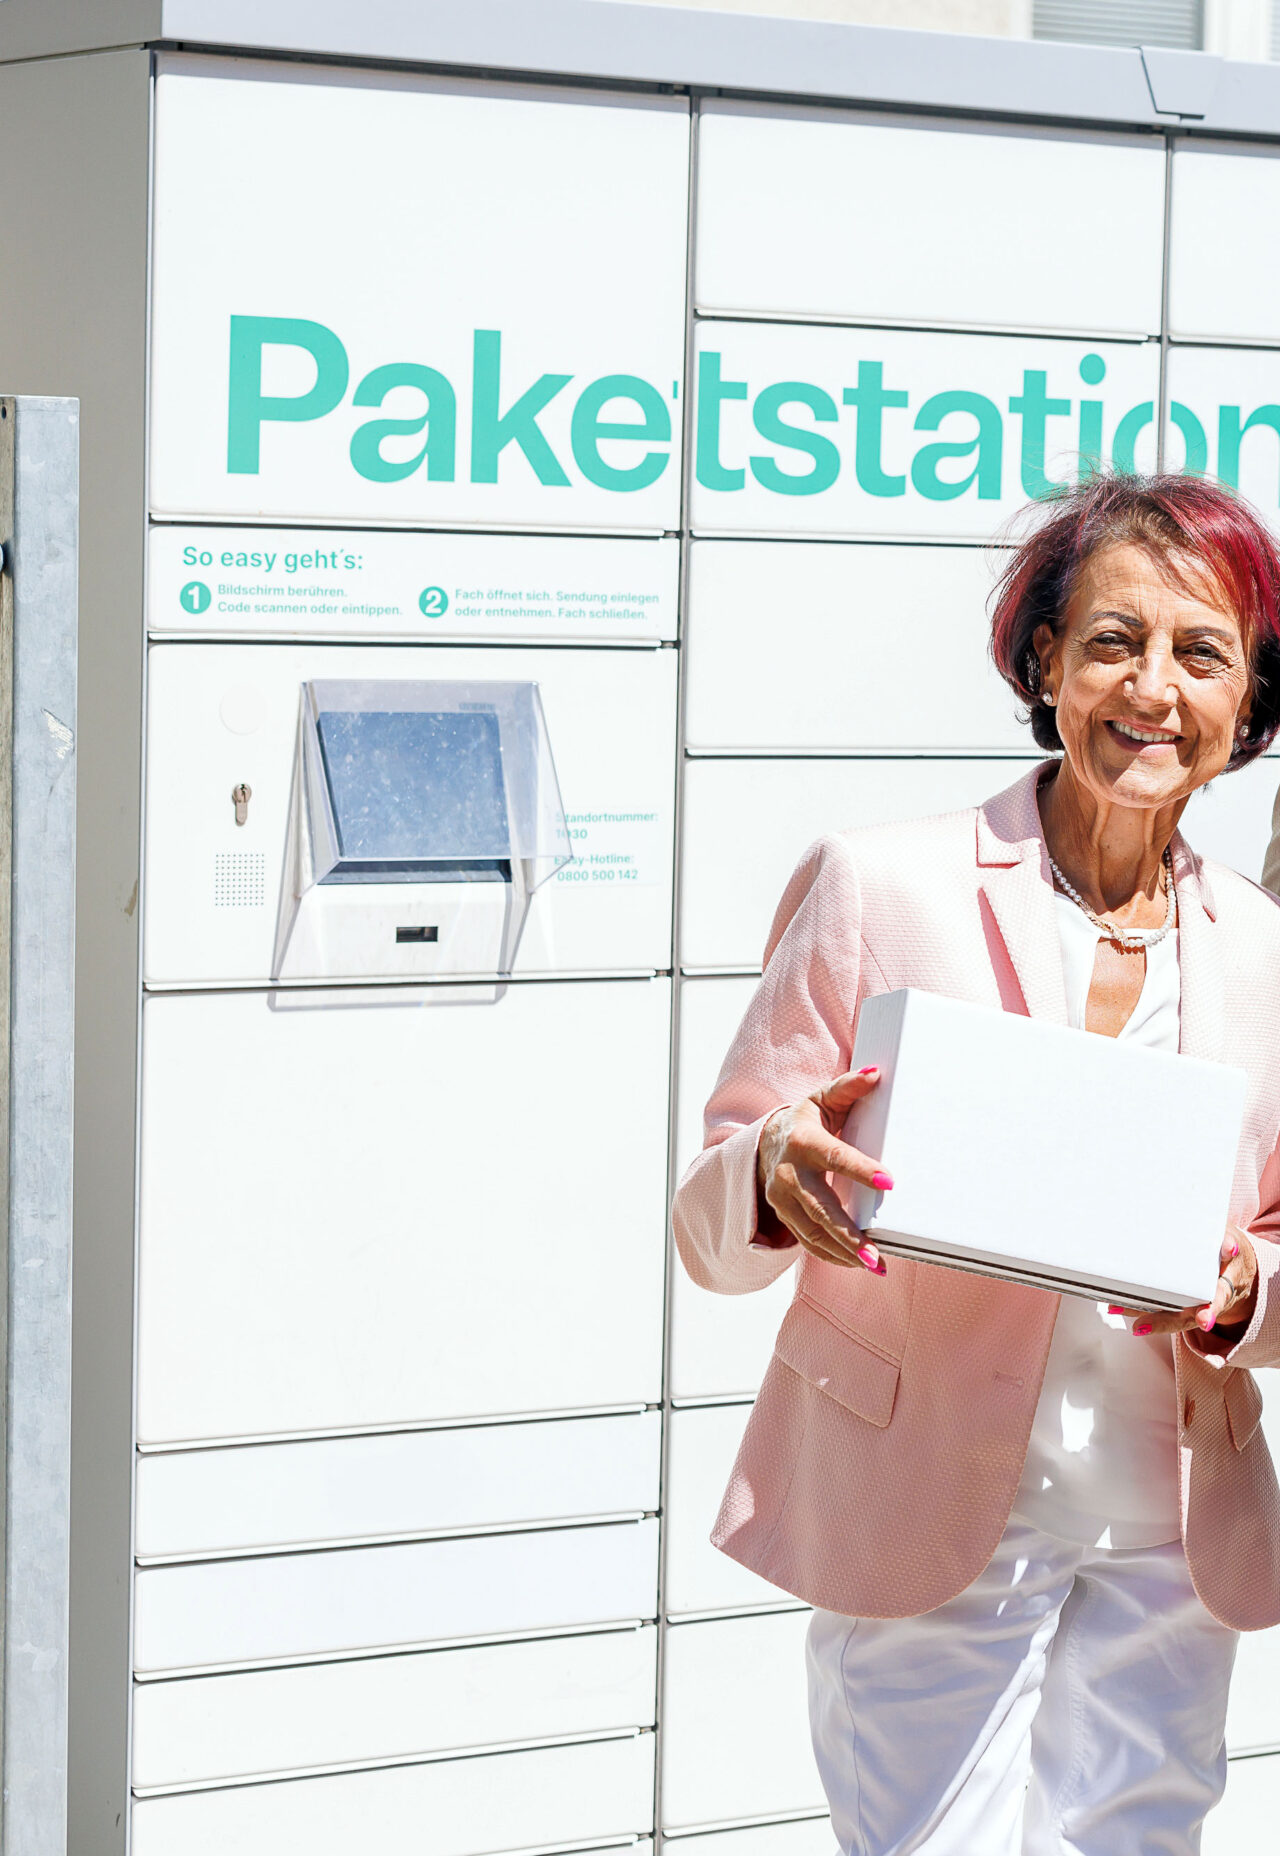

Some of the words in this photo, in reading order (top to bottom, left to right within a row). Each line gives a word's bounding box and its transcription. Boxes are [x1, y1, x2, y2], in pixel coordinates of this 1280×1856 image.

[182, 546, 213, 566] So
[220, 551, 277, 572] easy
[217, 584, 284, 596] Bildschirm
[288, 584, 348, 598] berühren.
[455, 589, 484, 601] Fach
[487, 589, 523, 601] öffnet
[525, 590, 552, 602] sich.
[556, 591, 608, 604] Sendung
[610, 592, 660, 605] einlegen
[217, 601, 250, 613] Code
[254, 604, 307, 614] scannen
[310, 603, 338, 615] oder
[341, 604, 403, 617] eintippen.
[454, 606, 482, 617] oder
[485, 607, 555, 619] entnehmen.
[558, 608, 586, 619] Fach
[588, 608, 648, 621] schließen.
[556, 811, 659, 823] Standortnummer:
[557, 871, 589, 882] 0800
[592, 870, 615, 881] 500
[618, 869, 639, 880] 142
